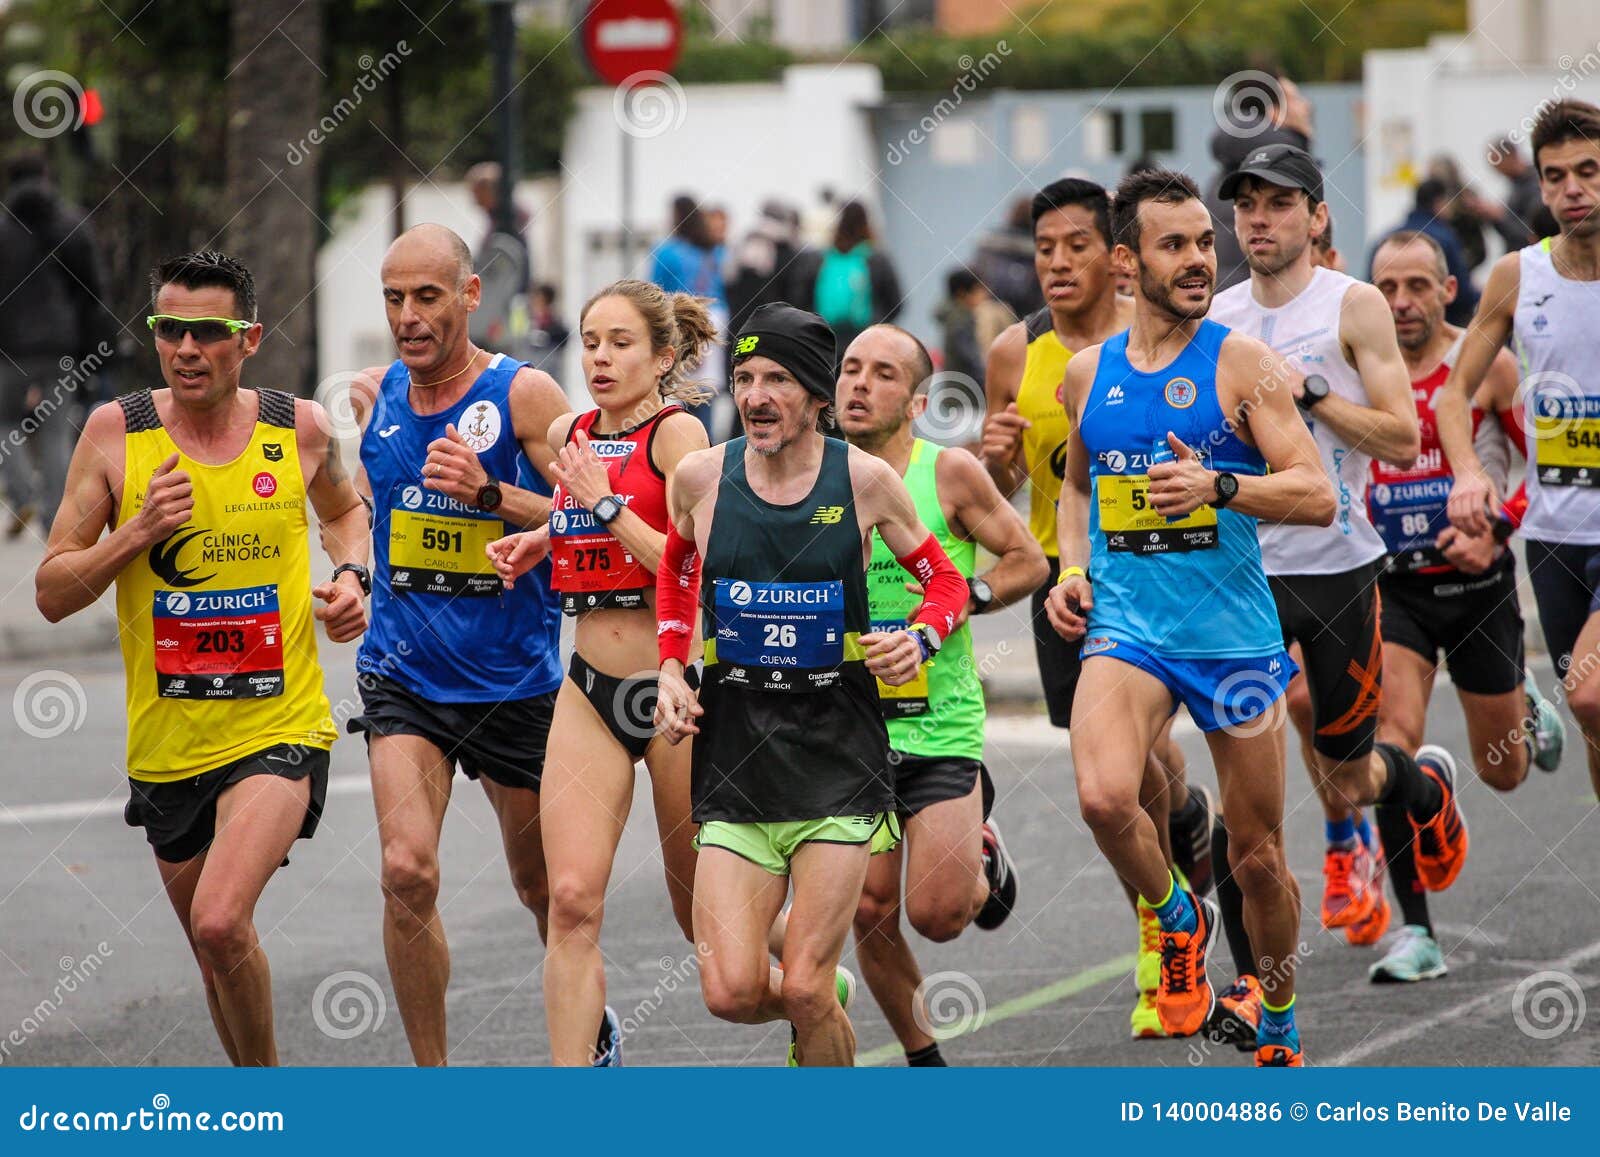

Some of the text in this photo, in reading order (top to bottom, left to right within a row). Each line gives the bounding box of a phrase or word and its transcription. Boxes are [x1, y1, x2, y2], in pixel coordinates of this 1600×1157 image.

[591, 443, 634, 455] ACOBS
[426, 494, 480, 512] ZURIC
[203, 533, 260, 548] CLÍNICA
[422, 528, 462, 553] 591
[202, 546, 280, 563] MENORCA
[574, 548, 610, 572] 275
[424, 559, 458, 570] CARLOS
[195, 592, 266, 611] ZURICH
[757, 589, 828, 603] ZURICH
[196, 630, 244, 653] 203
[764, 624, 796, 647] 26
[760, 656, 796, 665] CUEVAS
[249, 676, 280, 685] Cruzcampo
